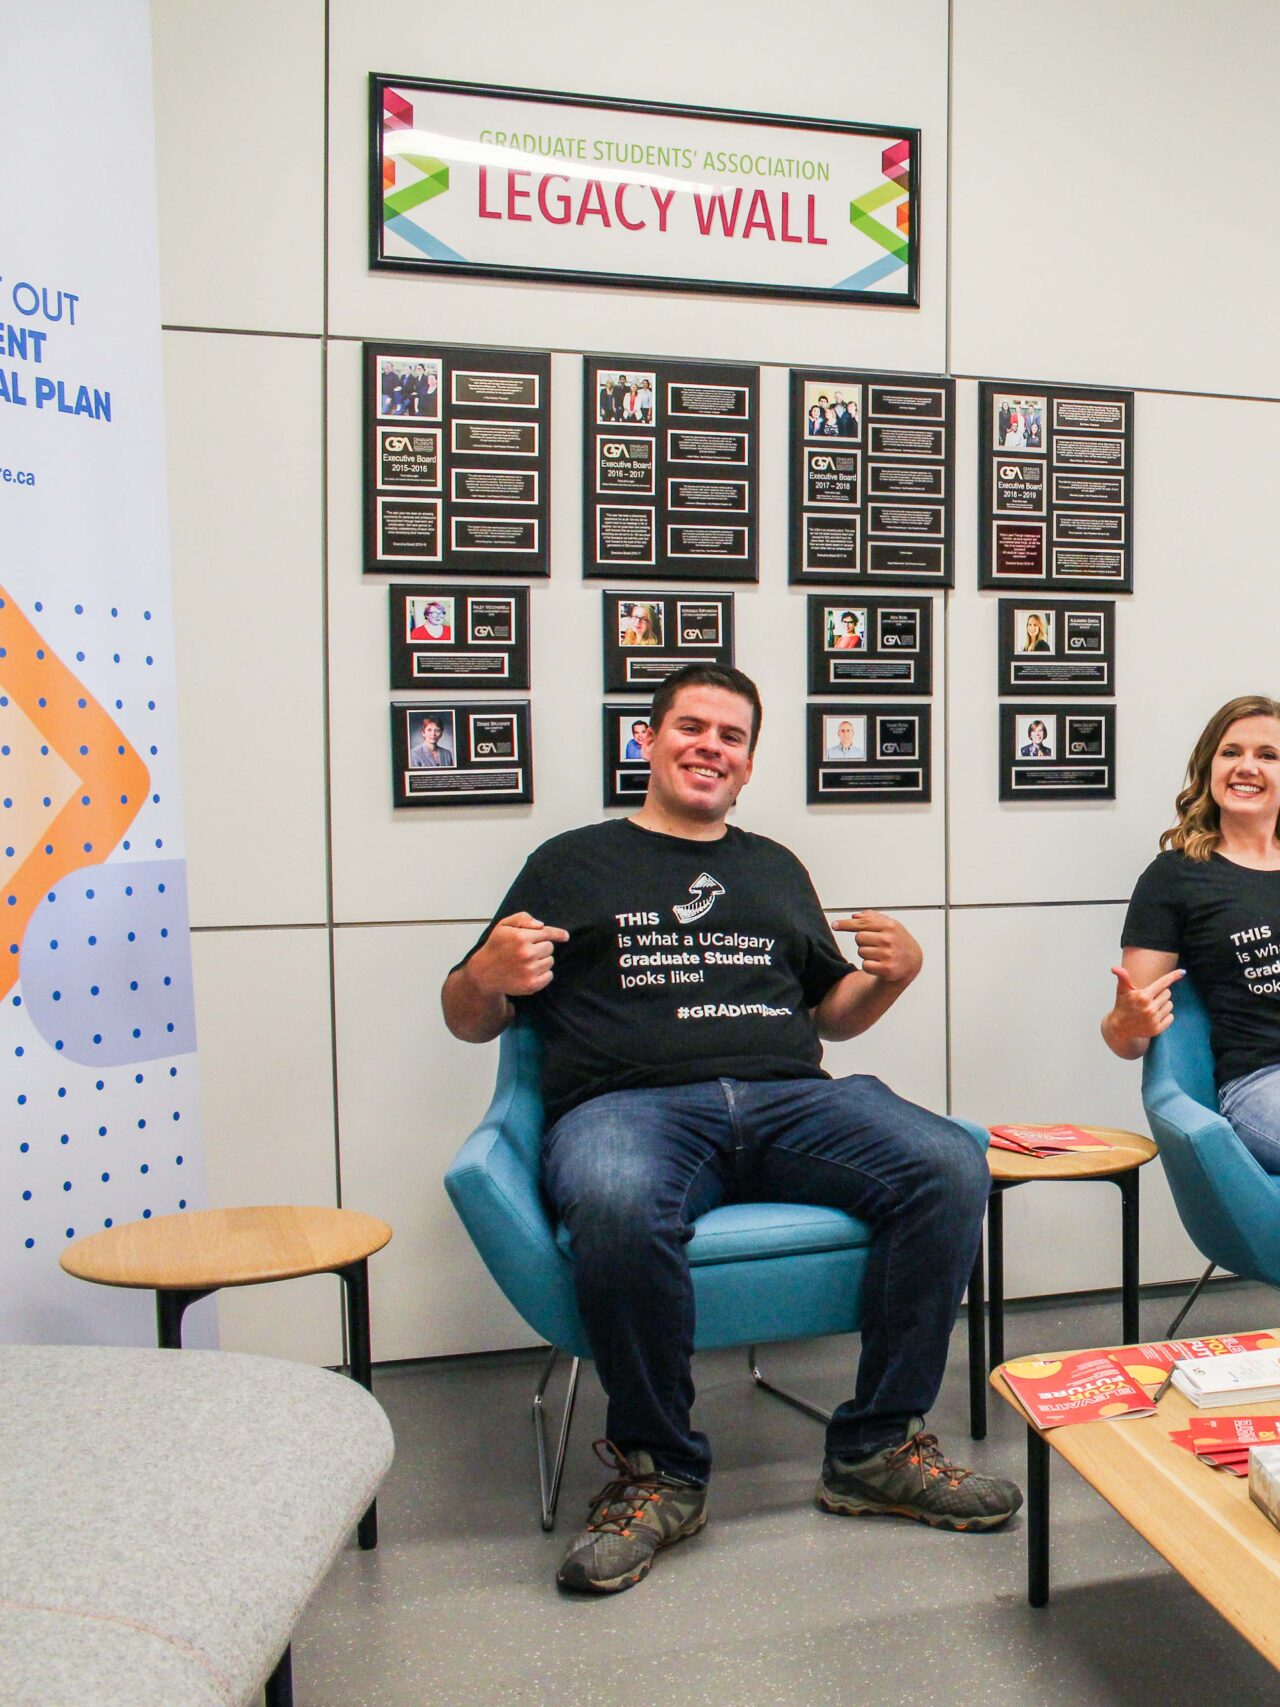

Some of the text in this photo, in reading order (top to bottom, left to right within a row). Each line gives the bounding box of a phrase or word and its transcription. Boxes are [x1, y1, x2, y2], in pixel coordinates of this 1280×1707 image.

[479, 129, 587, 161] GRADUATE
[702, 150, 830, 182] ASSOCIATION
[478, 165, 829, 246] LEGACY WALL
[12, 281, 80, 326] OUT
[35, 376, 112, 423] PLAN
[383, 454, 437, 464] Executive Board
[601, 459, 652, 470] Executive Board
[607, 469, 623, 478] 2016
[630, 470, 645, 479] 2017
[809, 471, 857, 482] Executive Board
[815, 481, 830, 490] 2017
[836, 482, 850, 491] 2018
[998, 481, 1043, 491] Executive Board
[1003, 490, 1018, 499] 2018
[1023, 491, 1037, 500] 2019
[615, 911, 660, 928] THIS
[617, 932, 775, 951] is what a UCalgary
[1230, 925, 1272, 947] THIS
[619, 951, 772, 968] Graduate Student
[1236, 951, 1251, 964] is
[621, 970, 705, 989] looks like!
[677, 1003, 792, 1019] #GRADImpact
[1038, 1374, 1126, 1400] FUTURE
[1067, 1381, 1129, 1402] YOUR
